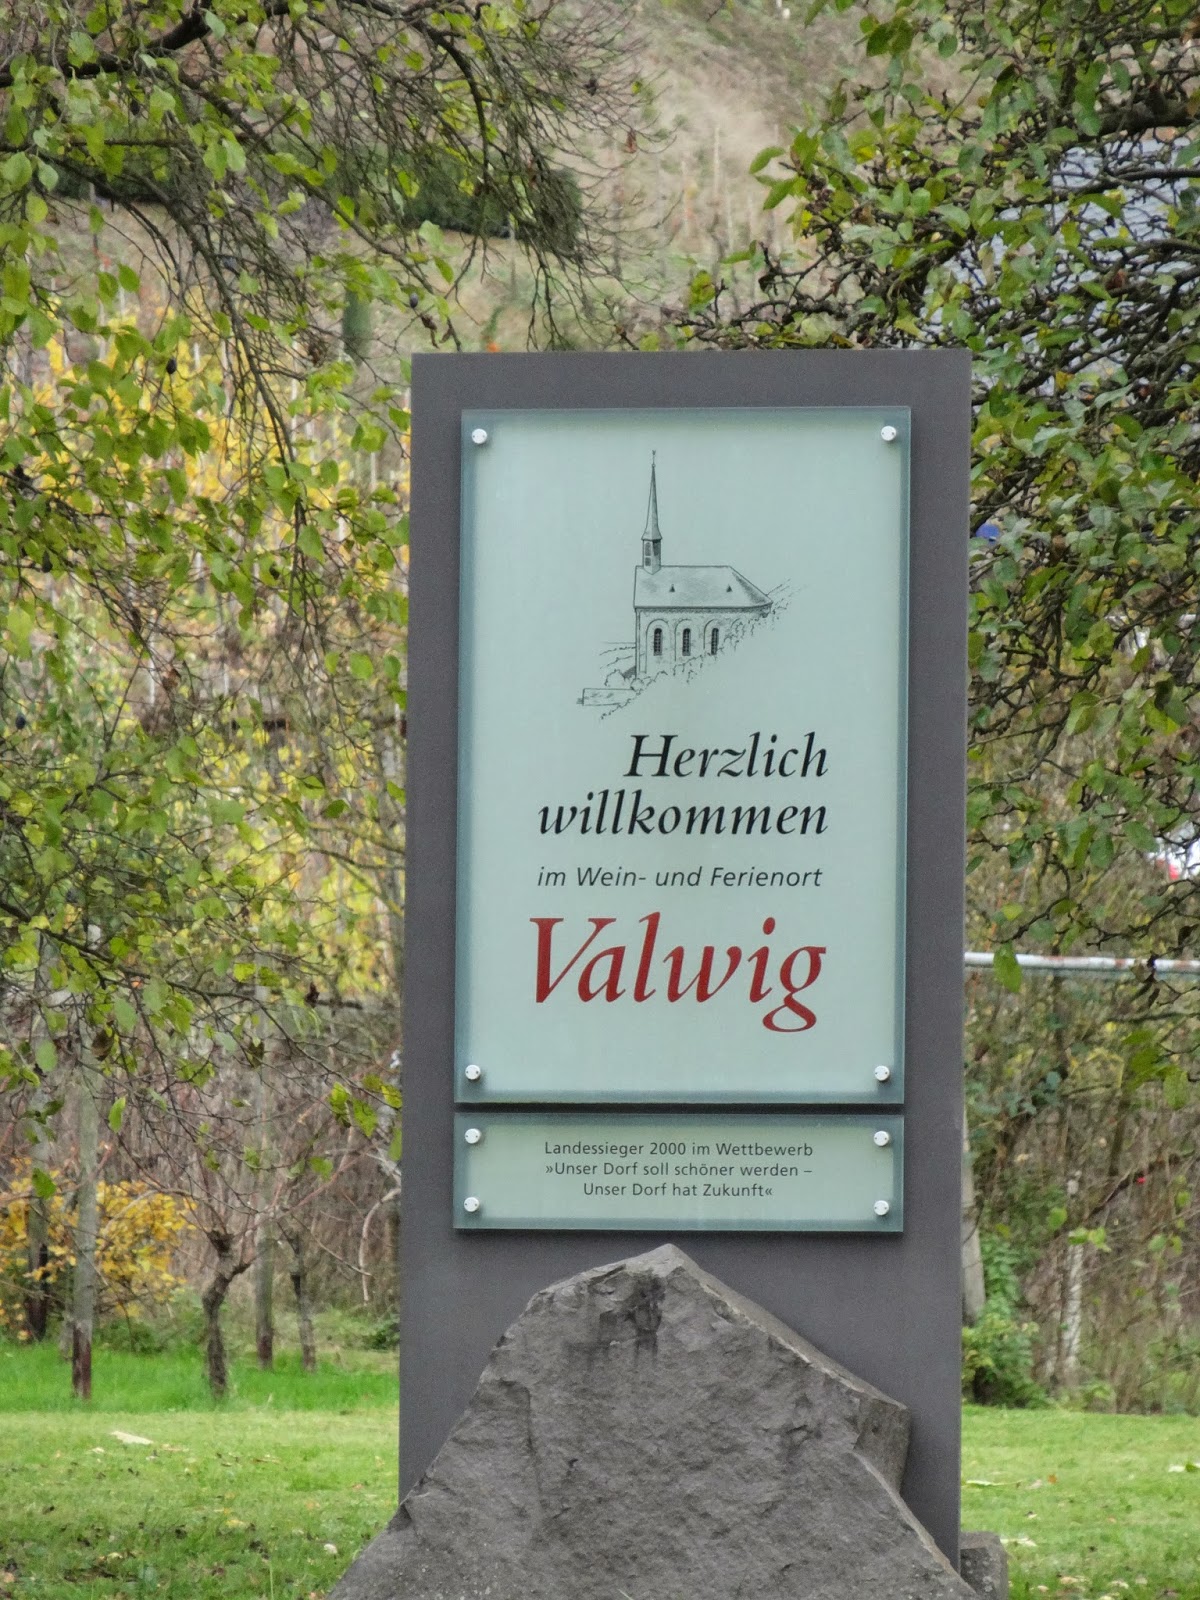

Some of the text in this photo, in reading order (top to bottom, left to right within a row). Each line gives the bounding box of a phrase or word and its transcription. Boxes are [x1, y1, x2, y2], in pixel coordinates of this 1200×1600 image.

[623, 731, 829, 778] Herzlich
[537, 788, 829, 836] willkommen
[537, 866, 824, 888] im Wein- und Ferienort
[529, 911, 827, 1033] Valwig
[544, 1141, 813, 1157] Landessieger 2000 im Wettbewerb
[603, 1161, 638, 1176] Dorf
[643, 1162, 669, 1176] soll
[674, 1162, 735, 1177] schöner
[583, 1182, 628, 1197] Unser
[632, 1182, 668, 1197] Dorf
[672, 1183, 698, 1197] hat
